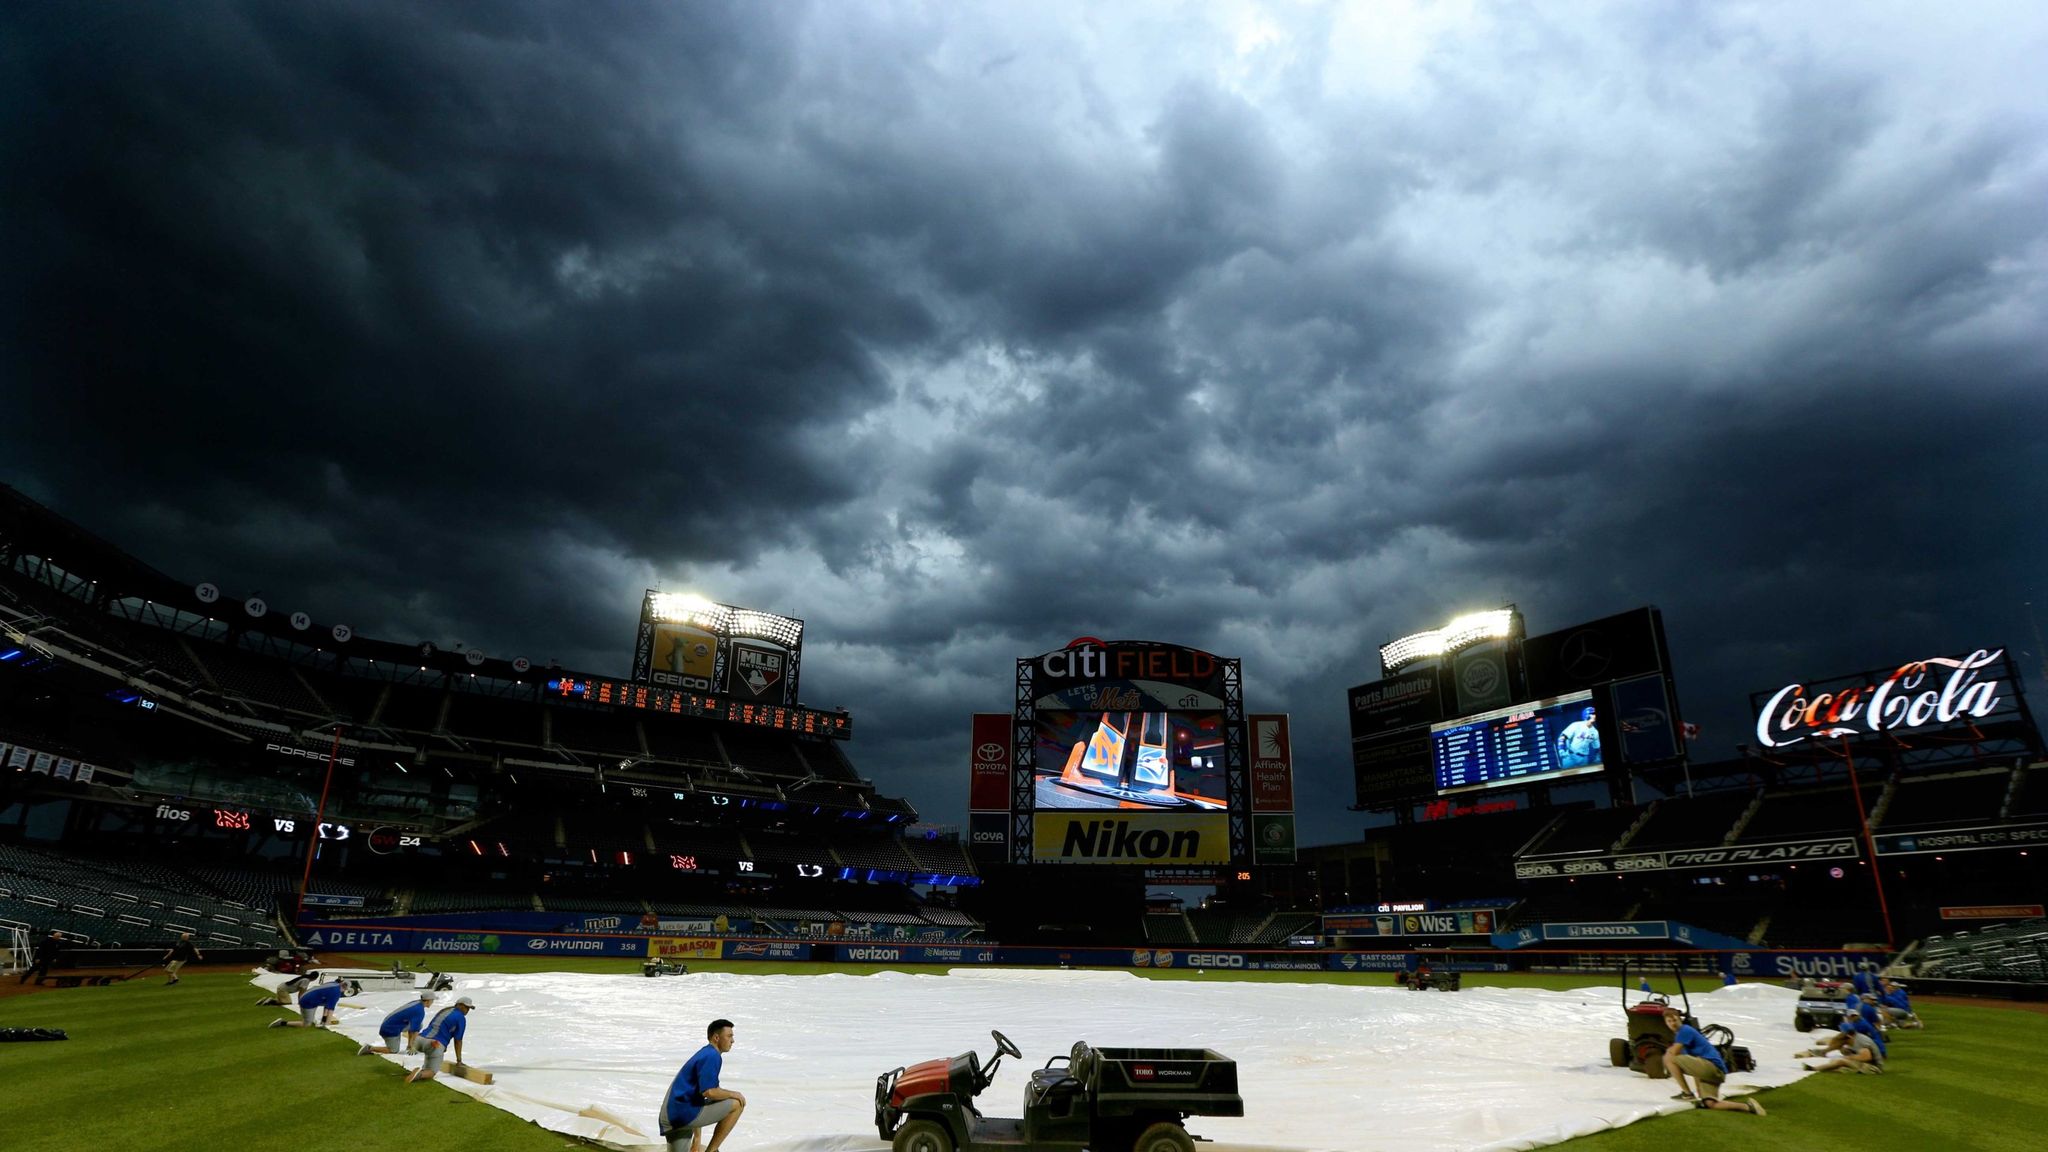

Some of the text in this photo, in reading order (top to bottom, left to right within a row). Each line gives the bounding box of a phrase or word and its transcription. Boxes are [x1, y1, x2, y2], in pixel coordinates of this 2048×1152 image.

[201, 587, 214, 598] 31
[250, 602, 263, 613] 41
[296, 615, 305, 625] 14
[335, 628, 348, 638] 37
[515, 660, 528, 669] 42
[740, 650, 780, 669] MLB
[1042, 645, 1217, 680] citi FIELD
[740, 662, 779, 673] NETWORK
[653, 671, 709, 690] GEICO
[1067, 684, 1097, 697] LET'S
[1355, 691, 1382, 707] Parts
[1382, 678, 1433, 700] Authority
[1083, 686, 1142, 711] GO Mets
[1178, 694, 1199, 708] citi
[1757, 648, 2005, 748] Coca-Cola
[266, 743, 356, 767] PORSCHE
[974, 763, 1008, 771] TOYOTA
[1254, 761, 1287, 772] Affinity
[1256, 771, 1286, 781] Health
[1262, 781, 1281, 791] Plan
[155, 805, 191, 821] fios
[399, 836, 421, 847] 24
[973, 832, 1004, 841] GOYA
[1061, 820, 1201, 858] Nikon
[1917, 834, 1980, 847] HOSPITAL
[1980, 832, 2007, 843] FOR
[1668, 842, 1853, 865] PRO PLAYER
[1237, 872, 1251, 880] 2:05
[1393, 904, 1424, 912] PAVILION
[1418, 915, 1455, 932] WISE
[1582, 926, 1639, 936] HONDA
[330, 932, 393, 945] DELTA
[422, 938, 480, 951] Advisors
[551, 941, 604, 950] HYUNDAI
[620, 943, 636, 951] 358
[849, 946, 899, 960] verizon
[933, 948, 962, 957] National
[978, 951, 993, 962] citi
[1133, 954, 1150, 964] Gulf
[1155, 954, 1172, 964] Gulf
[1187, 954, 1243, 967] GEICO
[1494, 963, 1508, 971] 370
[1775, 955, 1881, 977] StubHub
